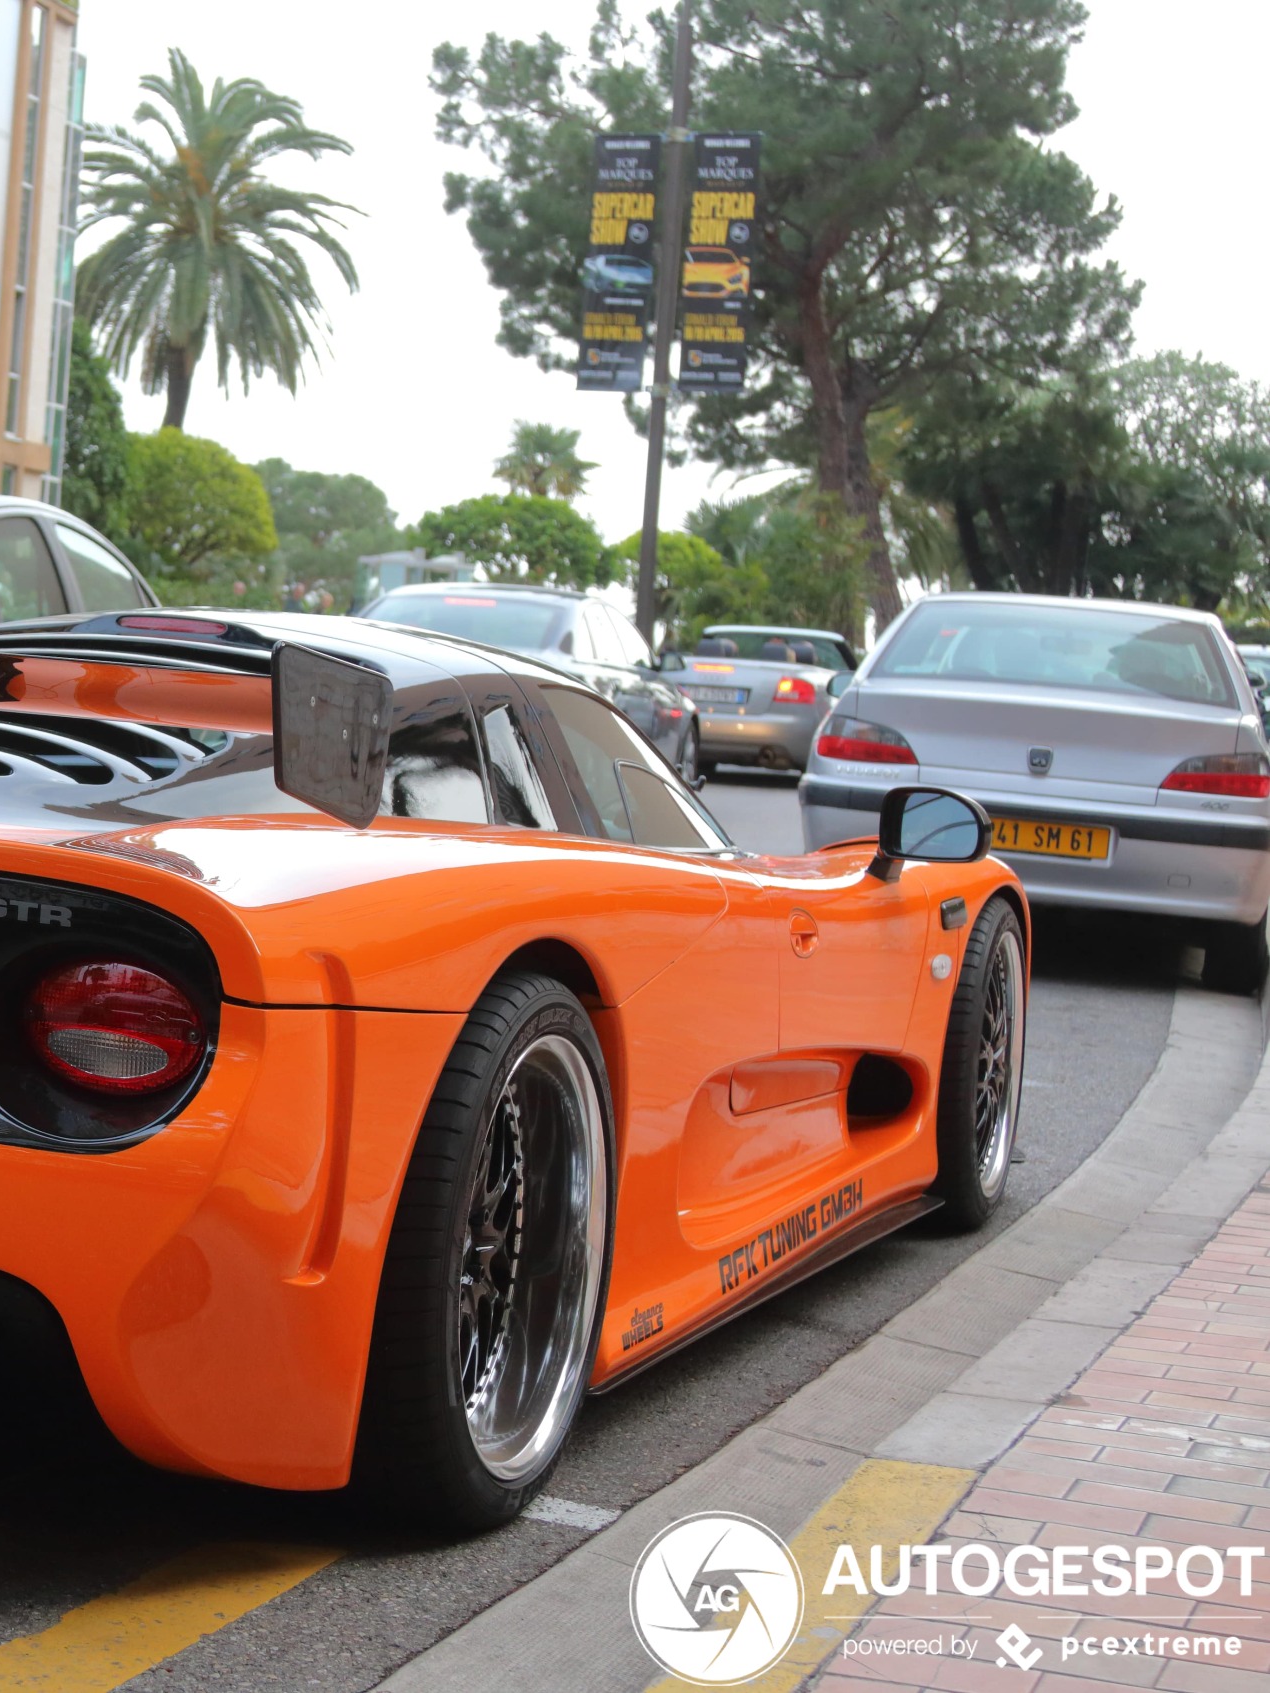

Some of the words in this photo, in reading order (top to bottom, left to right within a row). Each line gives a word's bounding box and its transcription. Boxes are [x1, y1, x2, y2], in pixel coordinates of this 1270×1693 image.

[697, 167, 754, 181] MARQUES
[592, 192, 655, 220] SUPERCAR
[692, 191, 755, 219] SUPERCAR
[990, 821, 1019, 845] 41
[1034, 826, 1061, 849] SM
[1071, 829, 1093, 853] 61
[718, 1239, 759, 1295] RFK
[757, 1204, 817, 1268] TUNING
[820, 1178, 863, 1232] GMBH
[622, 1313, 664, 1351] WHEELS
